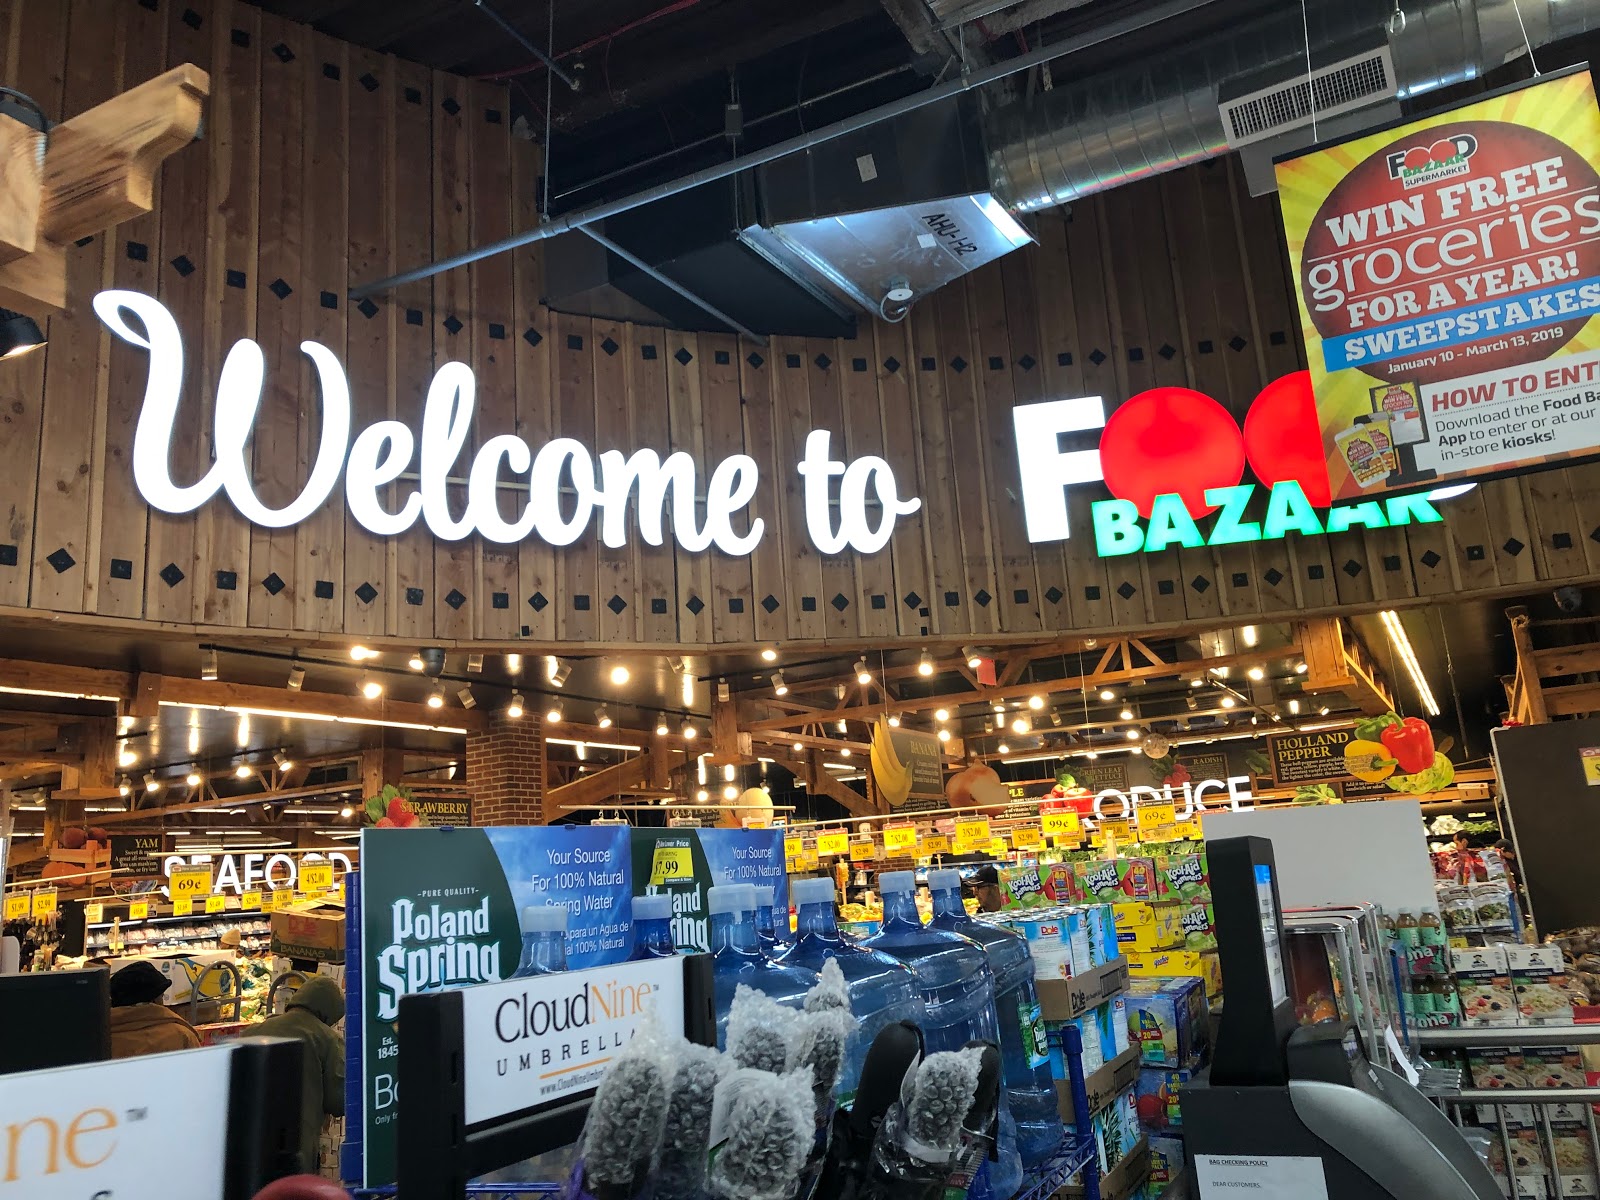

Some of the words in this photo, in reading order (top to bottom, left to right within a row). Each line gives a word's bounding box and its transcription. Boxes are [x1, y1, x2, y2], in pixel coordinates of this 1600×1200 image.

[1402, 153, 1465, 178] BAZAAR
[1405, 165, 1468, 187] SUPERMARKET
[1325, 194, 1425, 248] WIN
[1436, 156, 1568, 219] FREE
[1308, 194, 1600, 312] groceries
[1346, 287, 1423, 328] FOR
[1427, 281, 1457, 310] A
[1457, 250, 1580, 301] YEAR!
[1344, 284, 1600, 362] SWEEPSTAKES
[1387, 355, 1437, 374] January
[1439, 351, 1454, 362] 10
[1466, 339, 1508, 357] March
[1510, 335, 1529, 346] 13,
[1532, 326, 1564, 343] 2019
[1432, 382, 1497, 412] HOW
[1502, 374, 1538, 397] TO
[1545, 361, 1600, 389] ENT
[1435, 407, 1511, 432] Download
[1514, 402, 1540, 417] the
[1543, 393, 1582, 411] Food
[92, 289, 765, 556] Welcome
[798, 429, 922, 555] to
[1438, 433, 1467, 447] App
[1470, 430, 1485, 441] to
[1488, 420, 1527, 437] enter
[1531, 417, 1547, 429] or
[1551, 412, 1566, 425] at
[1570, 407, 1596, 421] our
[1440, 442, 1499, 461] in-store
[1502, 429, 1556, 450] kiosks!
[910, 740, 938, 757] BANANA
[1277, 732, 1348, 750] HOLLAND
[1193, 756, 1223, 766] RADISH
[1278, 746, 1332, 762] PEPPER
[400, 801, 469, 814] STRAWBERRY
[1145, 811, 1166, 821] 69¢
[1049, 820, 1069, 829] 99¢
[135, 838, 159, 848] YAM
[547, 849, 571, 865] Your
[574, 847, 611, 864] Source
[732, 846, 748, 859] Your
[748, 846, 772, 859] Source
[724, 866, 735, 880] For
[737, 865, 757, 878] 100%
[758, 864, 782, 877] Natural
[1083, 865, 1117, 887] Kool-Aid
[1165, 859, 1201, 881] Kool-Aid
[178, 878, 201, 891] 69¢
[531, 874, 551, 892] For
[554, 871, 585, 889] 100%
[588, 869, 624, 887] Natural
[1007, 870, 1039, 892] Kool-Aid
[1092, 879, 1119, 895] Jammers
[1173, 872, 1203, 890] Jammers
[1015, 882, 1041, 900] Jammers
[11, 902, 24, 913] $1.99
[37, 900, 51, 910] $2.99
[583, 894, 613, 911] Water
[779, 904, 786, 914] de
[391, 896, 490, 945] Poland
[588, 927, 597, 936] un
[599, 923, 618, 937] Agua
[620, 921, 629, 932] de
[1184, 922, 1209, 934] ammers
[1040, 926, 1059, 934] Dole
[280, 945, 326, 958] BANANAS
[575, 941, 597, 954] 100%
[599, 936, 625, 951] Natural
[1130, 952, 1140, 961] 32
[376, 936, 502, 1022] Spring
[1071, 989, 1086, 1010] Dole
[382, 1037, 394, 1046] Est.
[1143, 1031, 1152, 1040] 20
[377, 1044, 399, 1059] 1845
[375, 1114, 391, 1125] Only
